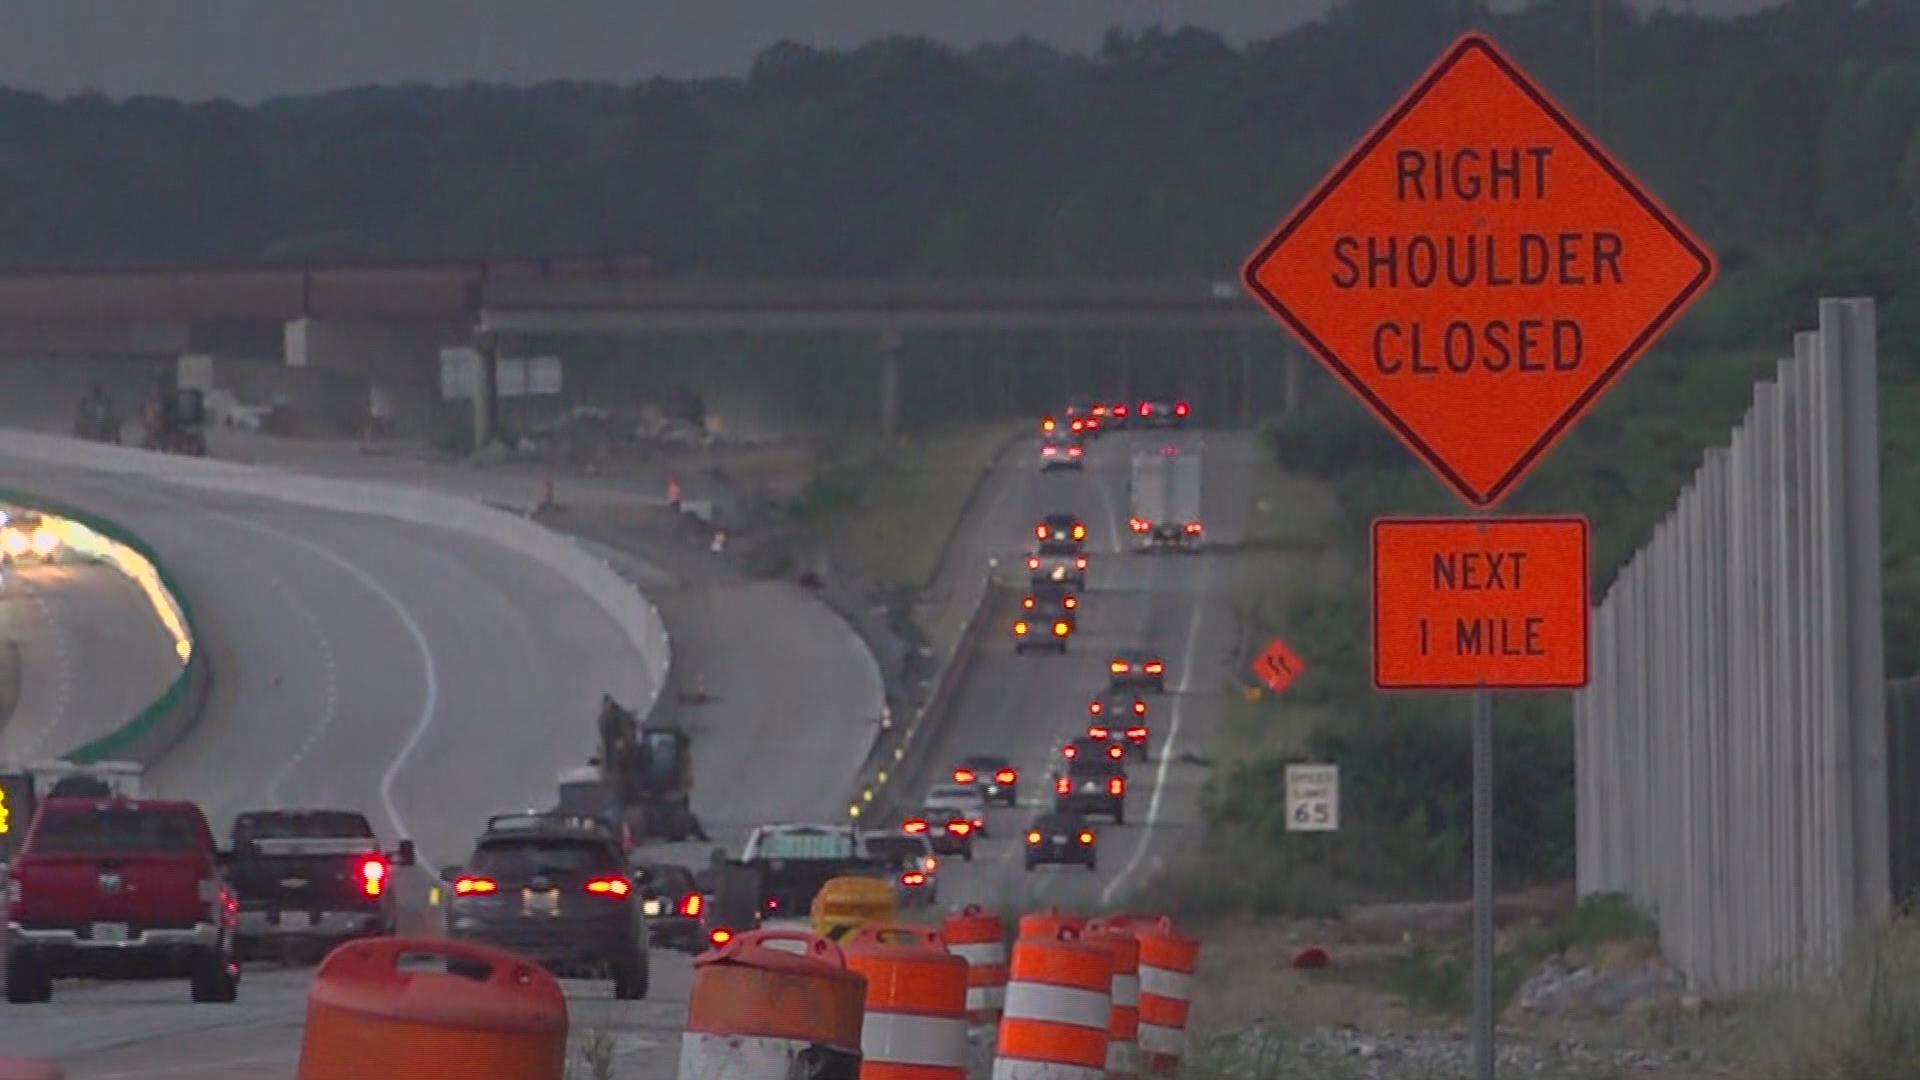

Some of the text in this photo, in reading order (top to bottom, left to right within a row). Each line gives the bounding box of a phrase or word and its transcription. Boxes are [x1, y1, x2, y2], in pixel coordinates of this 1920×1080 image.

[1396, 145, 1553, 202] RIGHT
[1330, 231, 1624, 290] SHOULDER
[1372, 318, 1584, 376] CLOSED
[1432, 551, 1527, 591] NEXT
[1418, 616, 1545, 656] 1 MILE
[1294, 803, 1329, 823] 65
